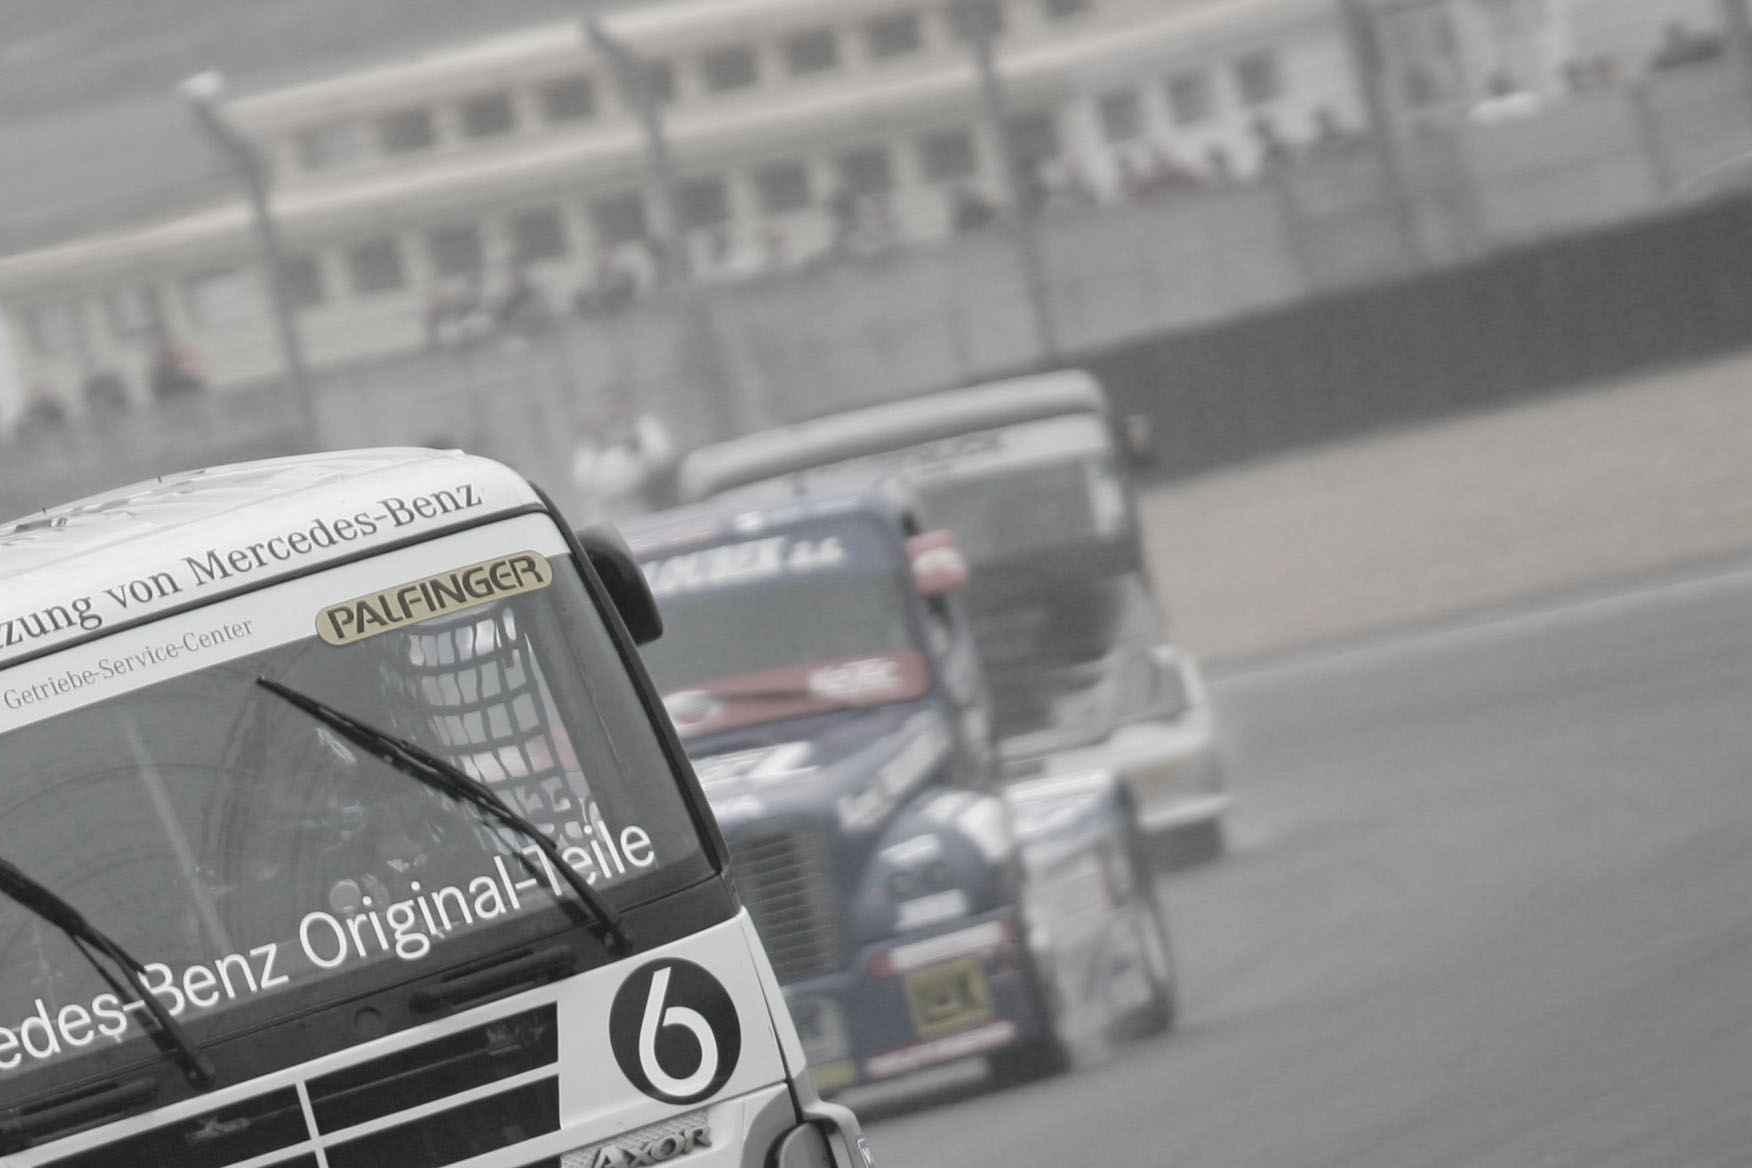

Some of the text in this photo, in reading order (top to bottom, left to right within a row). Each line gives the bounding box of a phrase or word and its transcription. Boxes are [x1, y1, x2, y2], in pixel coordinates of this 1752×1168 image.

[103, 571, 180, 610] von
[183, 482, 484, 587] Mercedes-Benz
[327, 555, 545, 640] PALFINGER
[3, 617, 254, 709] Getriebe-Service-Center
[299, 819, 656, 968] Original-Teile
[638, 966, 719, 1097] 6
